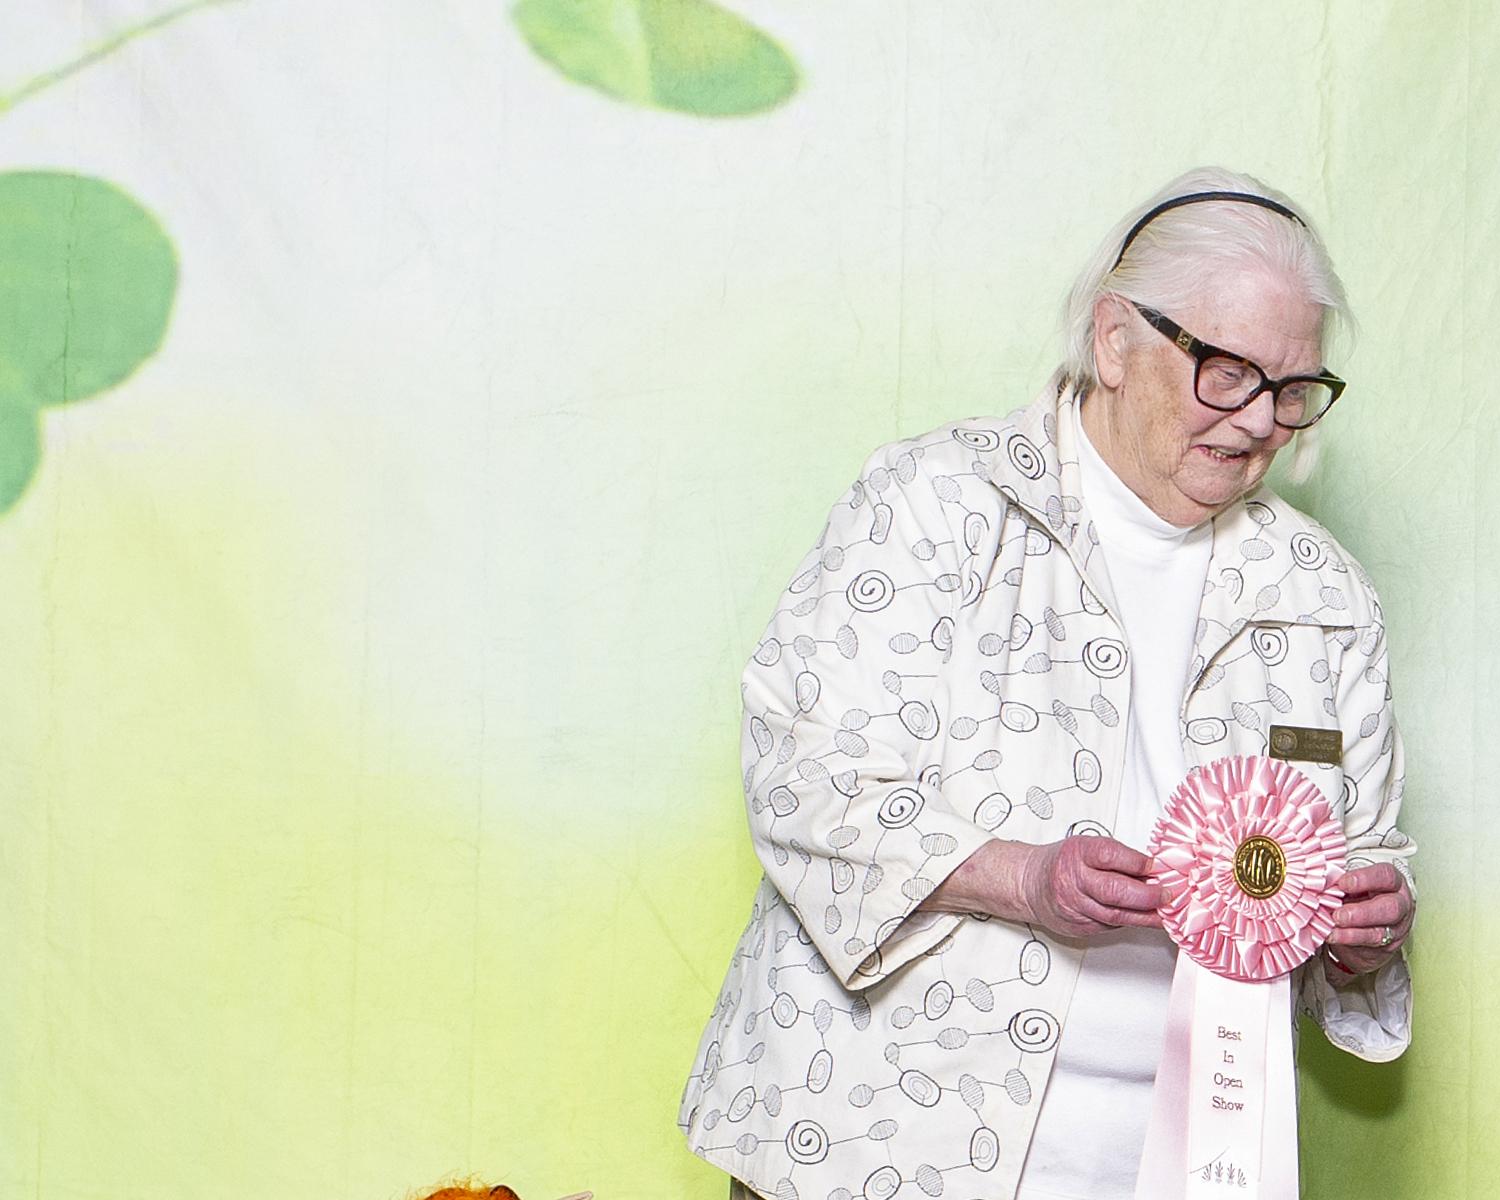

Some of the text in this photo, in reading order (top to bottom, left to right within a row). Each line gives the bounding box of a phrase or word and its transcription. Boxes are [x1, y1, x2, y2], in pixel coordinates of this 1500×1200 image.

[1217, 1026, 1242, 1041] Best
[1224, 1050, 1234, 1063] In
[1214, 1072, 1243, 1089] Open
[1212, 1095, 1244, 1111] Show
